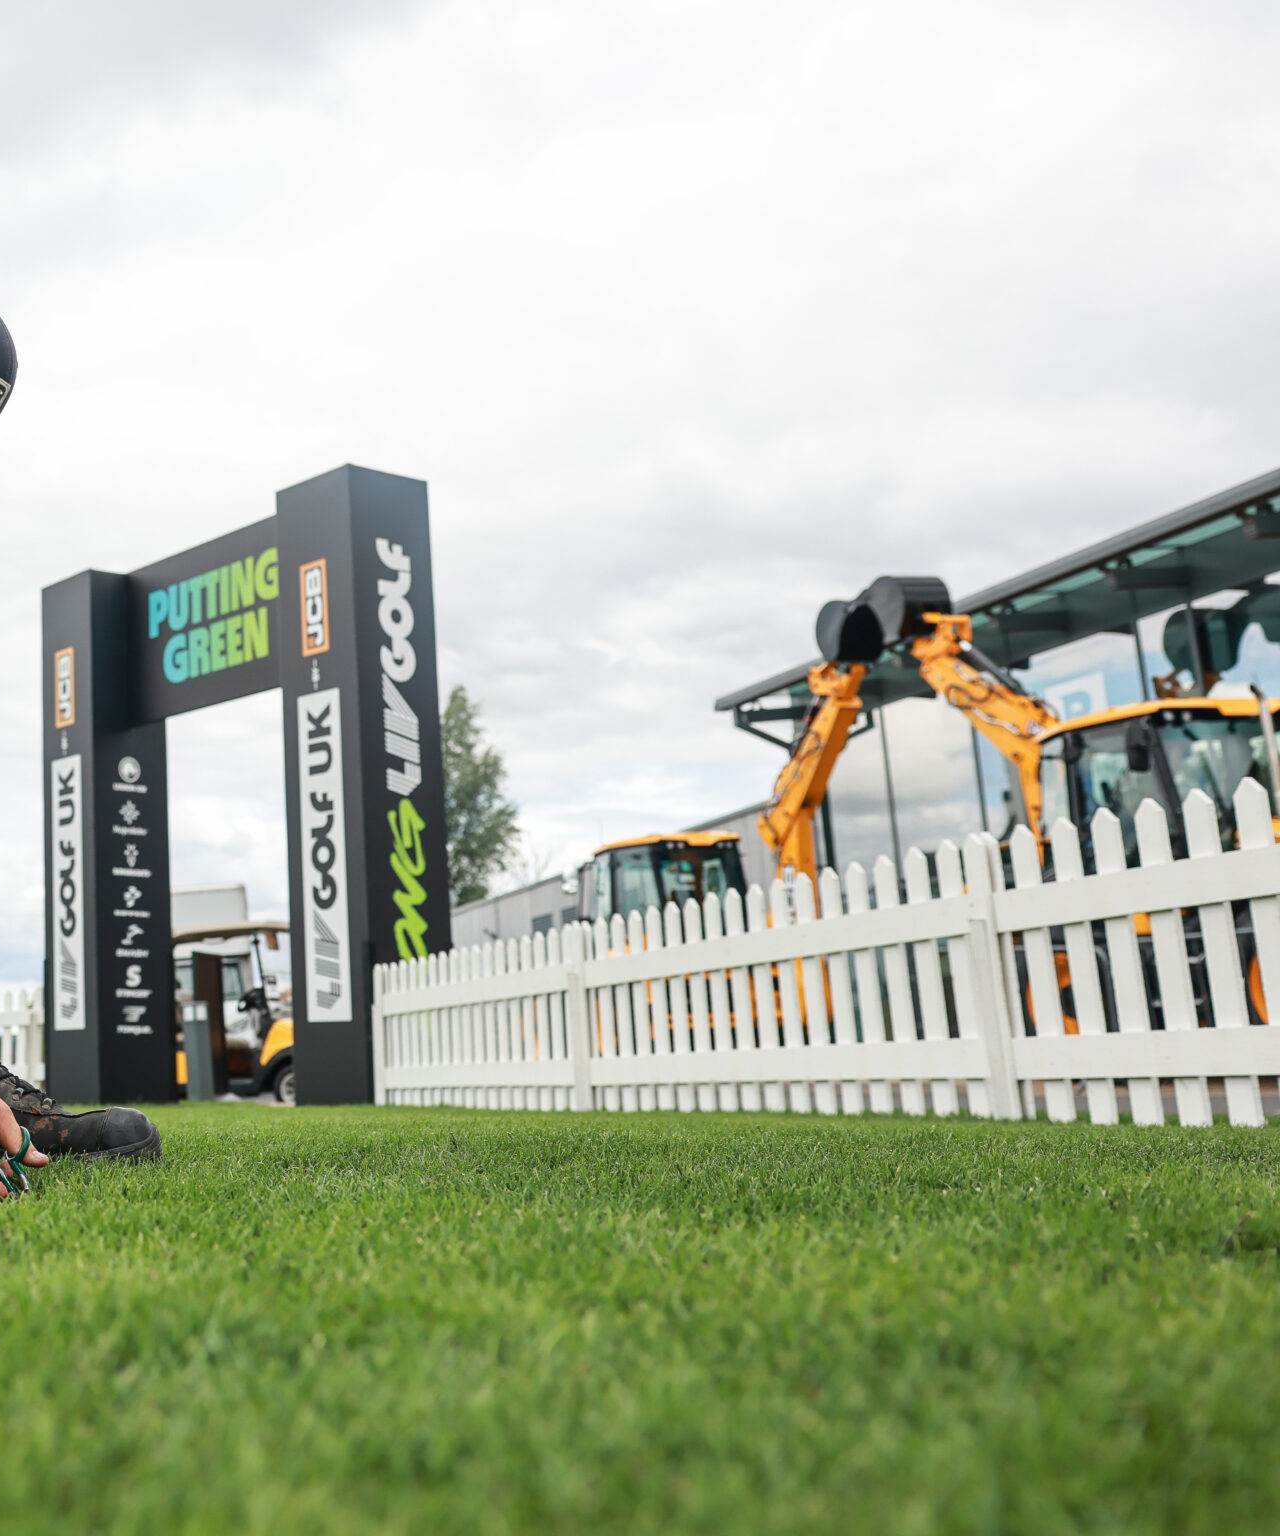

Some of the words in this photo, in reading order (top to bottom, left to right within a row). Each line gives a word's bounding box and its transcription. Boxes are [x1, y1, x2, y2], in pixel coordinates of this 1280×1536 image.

[148, 547, 279, 639] PUTTING
[304, 567, 325, 650] JCB
[375, 537, 418, 683] GOLF
[163, 606, 269, 684] GREEN
[58, 652, 73, 722] JCB
[306, 701, 334, 777] UK
[57, 767, 76, 827] UK
[58, 839, 76, 938] GOLF
[311, 791, 337, 910] GOLF
